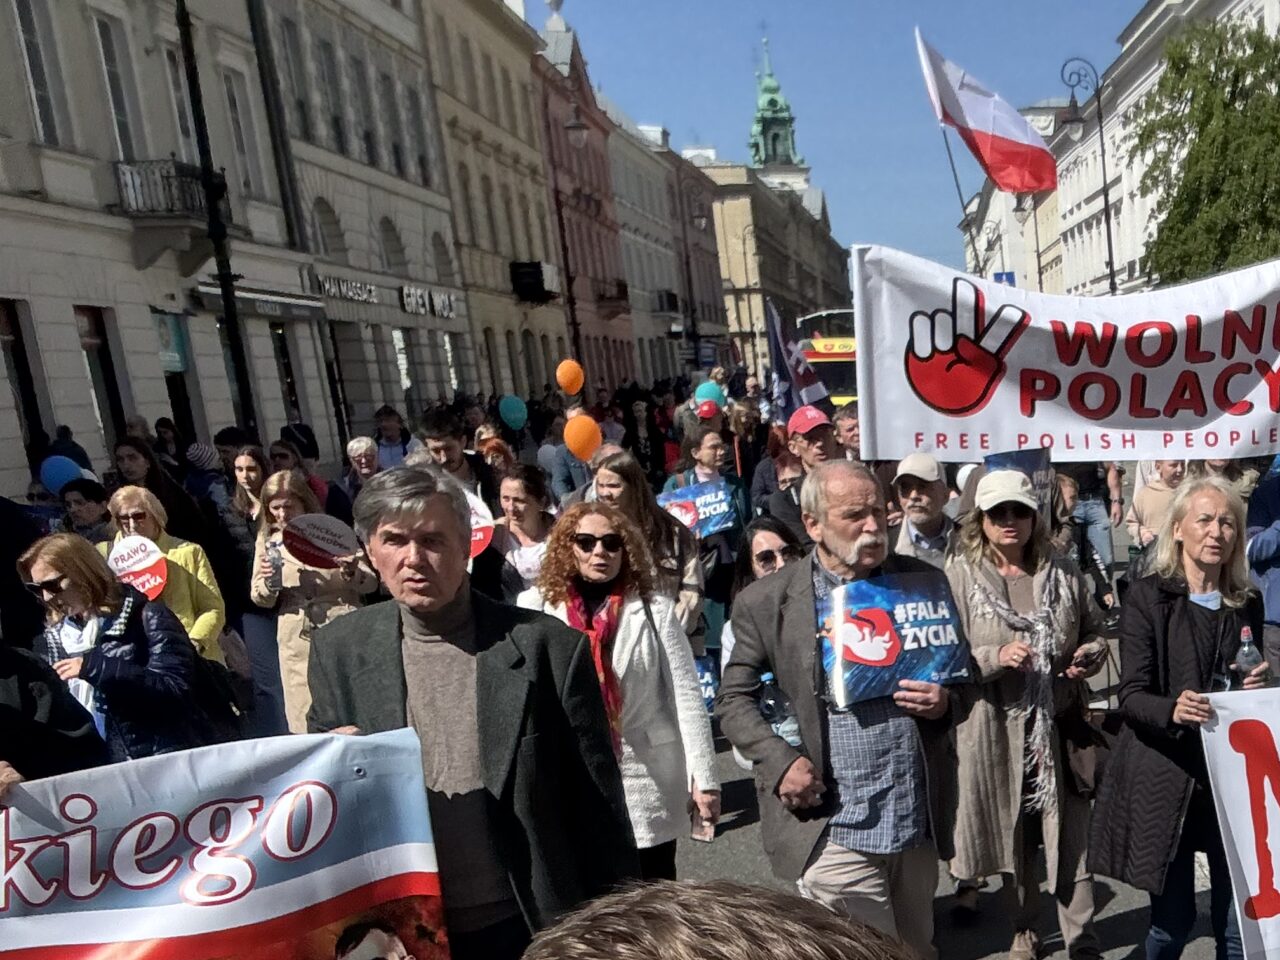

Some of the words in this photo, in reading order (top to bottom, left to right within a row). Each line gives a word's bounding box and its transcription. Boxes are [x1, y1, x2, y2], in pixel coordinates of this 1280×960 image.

[914, 431, 990, 450] FREE
[1017, 431, 1136, 449] POLISH
[1163, 427, 1279, 448] PEOPLE
[113, 542, 148, 567] PRAWO
[893, 600, 951, 624] #FALA
[900, 622, 960, 652] ŻYCIA
[0, 779, 339, 912] kiego
